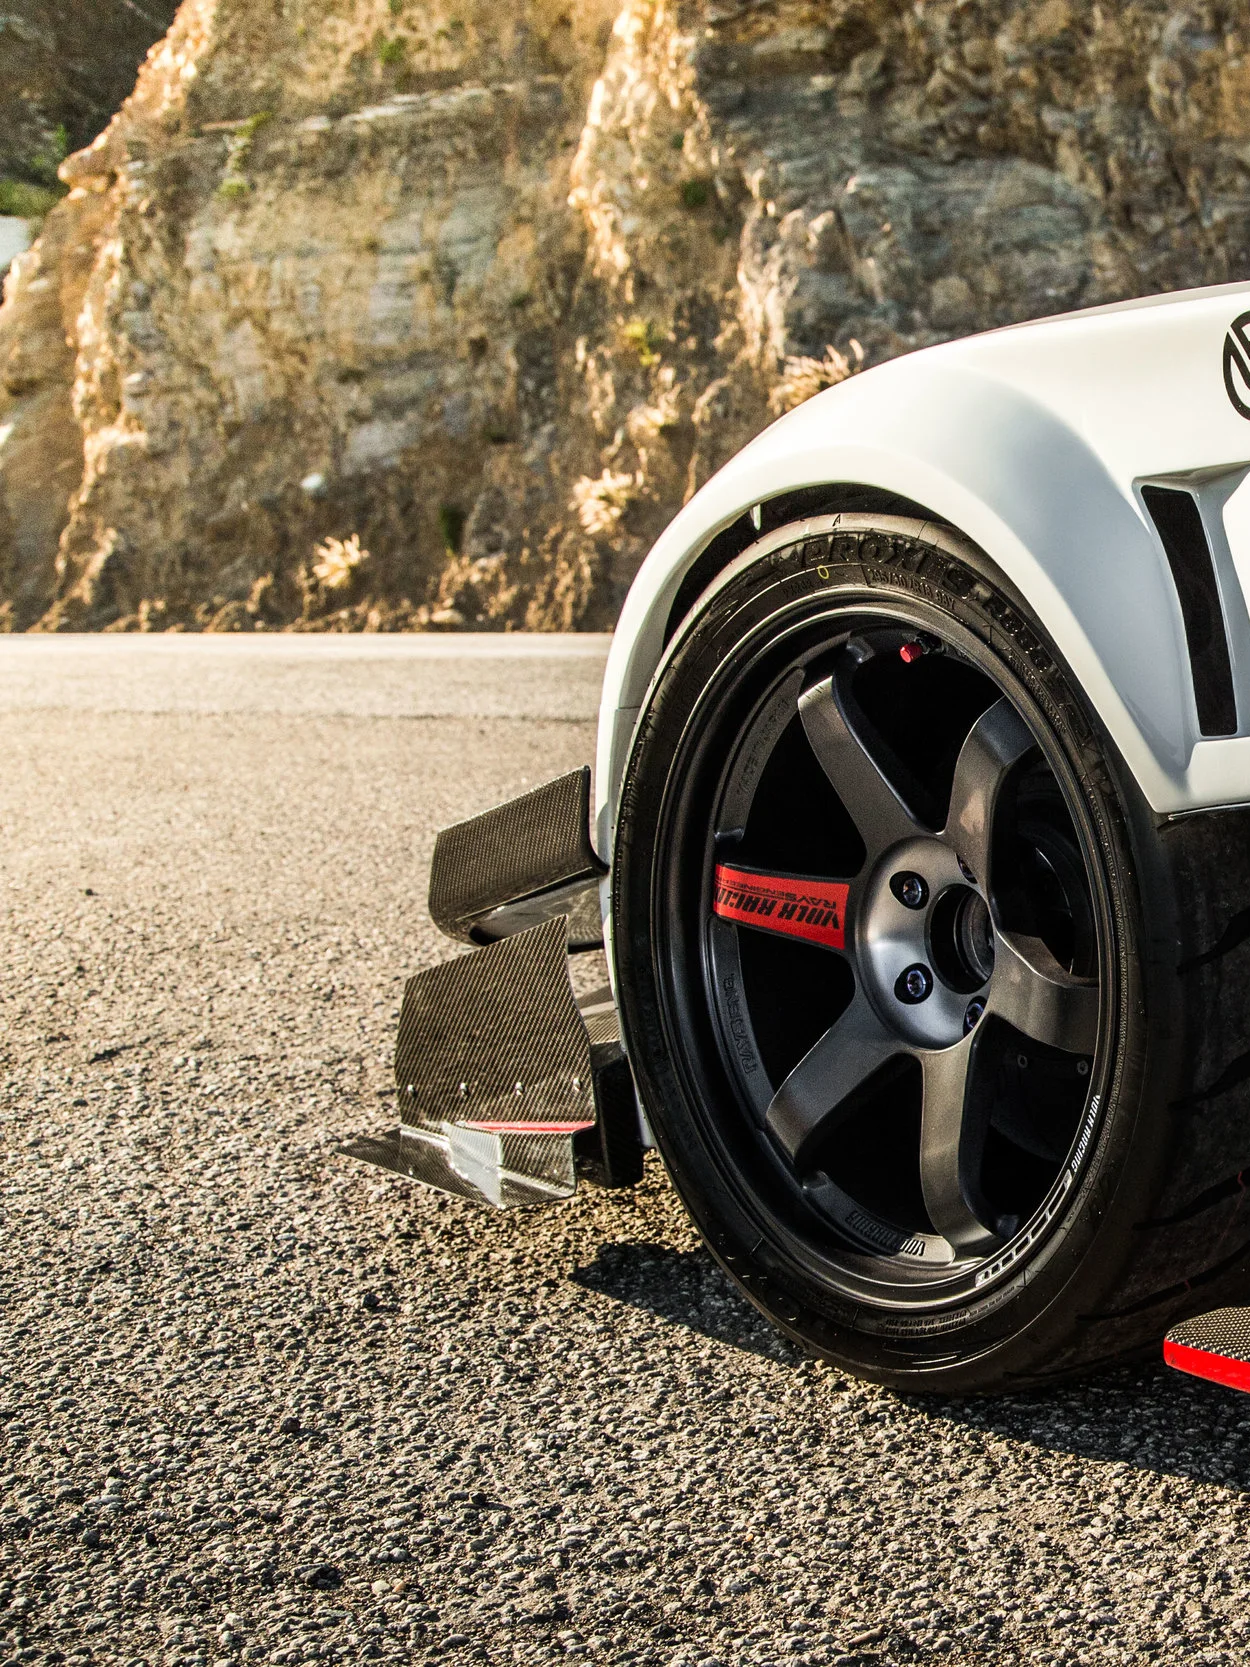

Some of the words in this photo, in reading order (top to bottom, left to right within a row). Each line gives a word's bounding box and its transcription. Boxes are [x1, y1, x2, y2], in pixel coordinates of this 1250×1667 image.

[777, 902, 840, 930] VOLK
[1086, 1094, 1101, 1128] VOLK
[1070, 1124, 1092, 1173] RACING
